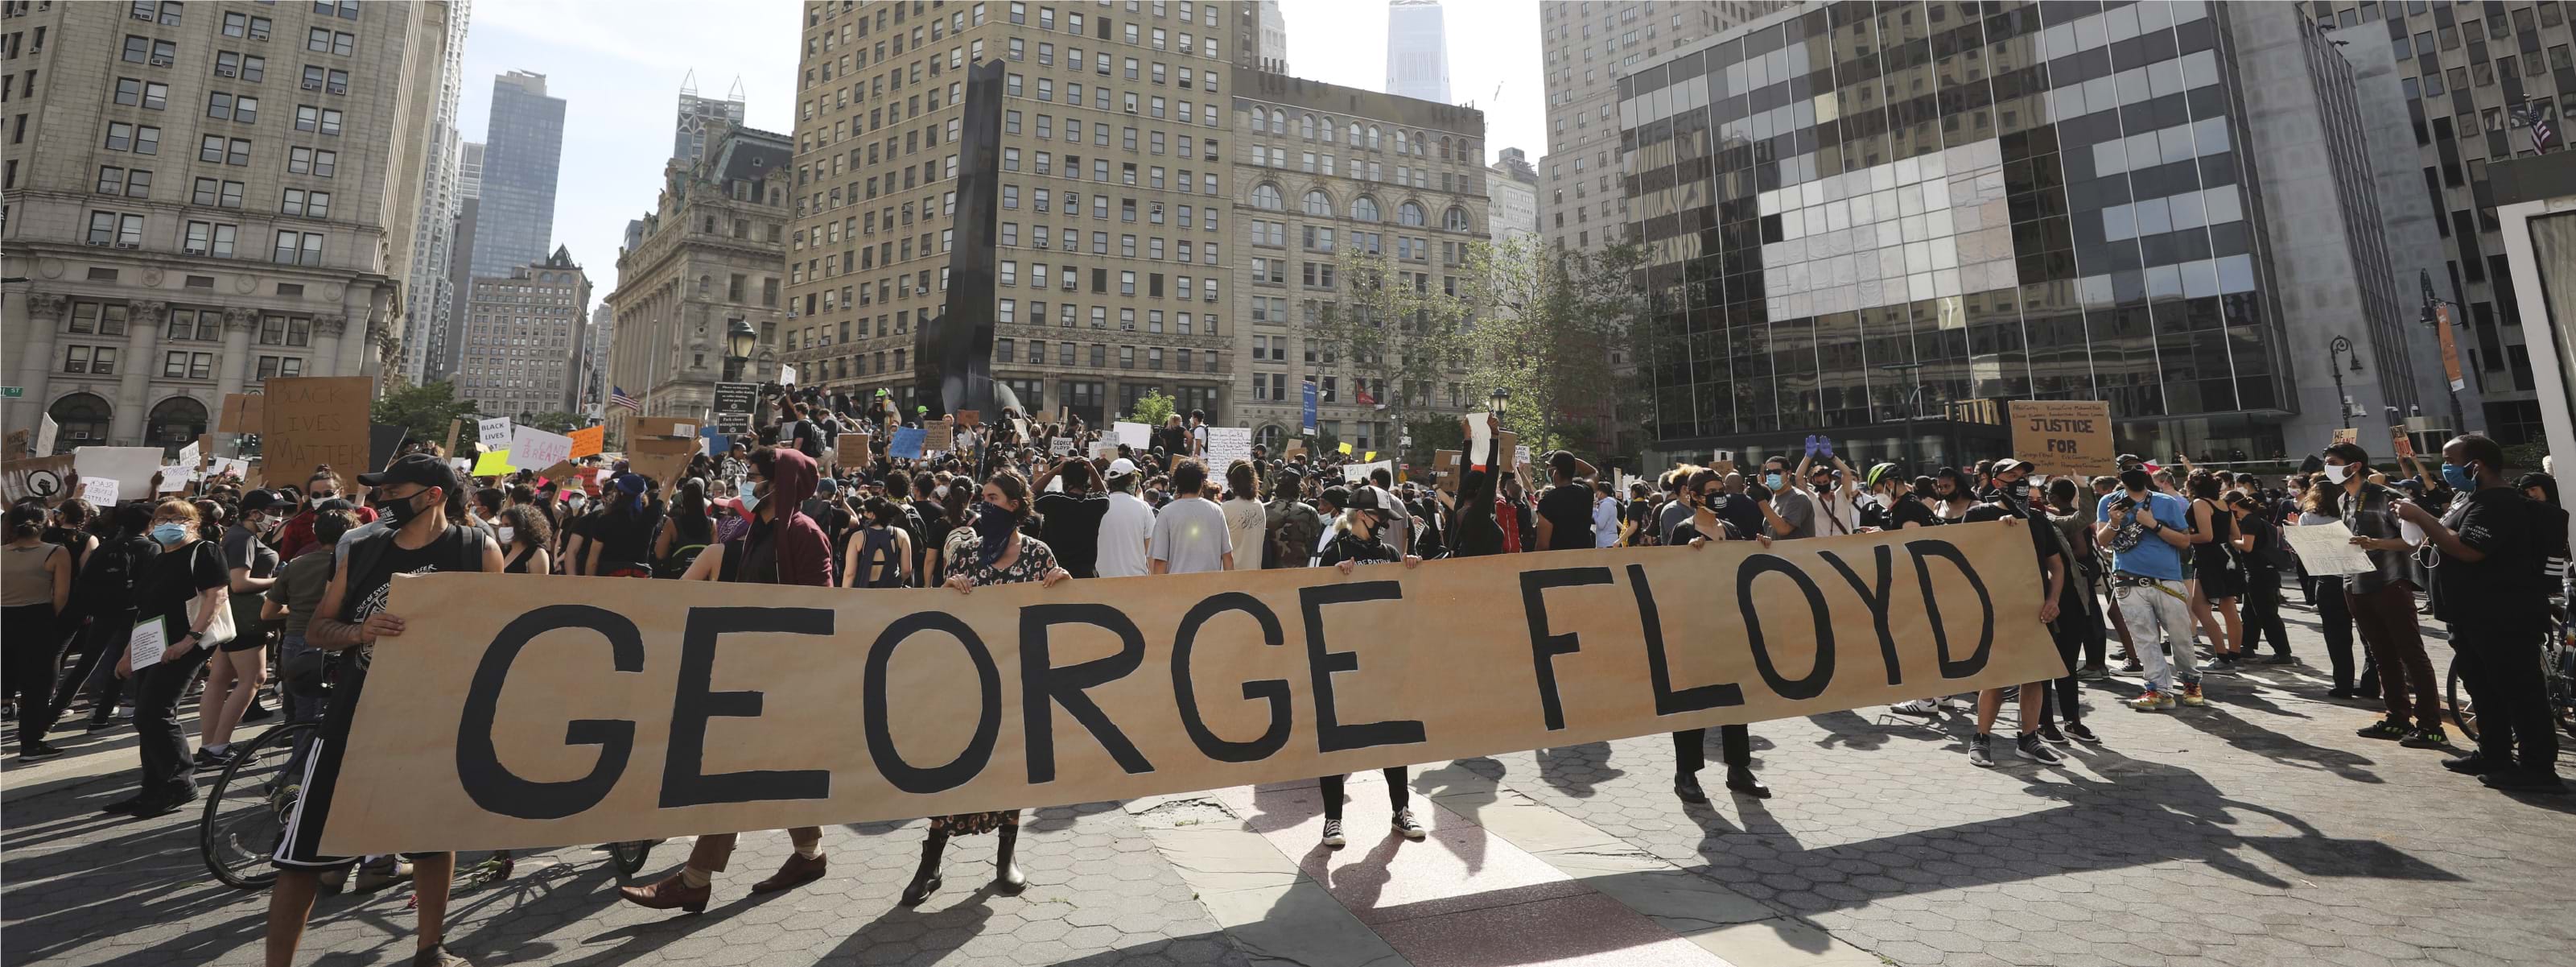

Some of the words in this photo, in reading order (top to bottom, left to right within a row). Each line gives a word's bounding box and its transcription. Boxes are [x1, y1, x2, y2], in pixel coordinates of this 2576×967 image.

[271, 382, 348, 405] BLACK
[272, 410, 342, 436] LIVES
[481, 422, 505, 432] BLACK
[2030, 419, 2094, 433] JUSTICE
[484, 432, 505, 440] LIVES
[2334, 430, 2344, 439] WE
[2046, 439, 2078, 453] FOR
[267, 437, 365, 470] MATTER
[2467, 527, 2492, 538] MADISON
[357, 600, 367, 613] OUT
[367, 593, 373, 601] OF
[455, 581, 1428, 820] GEORGE
[1519, 539, 1996, 731] FLOYD
